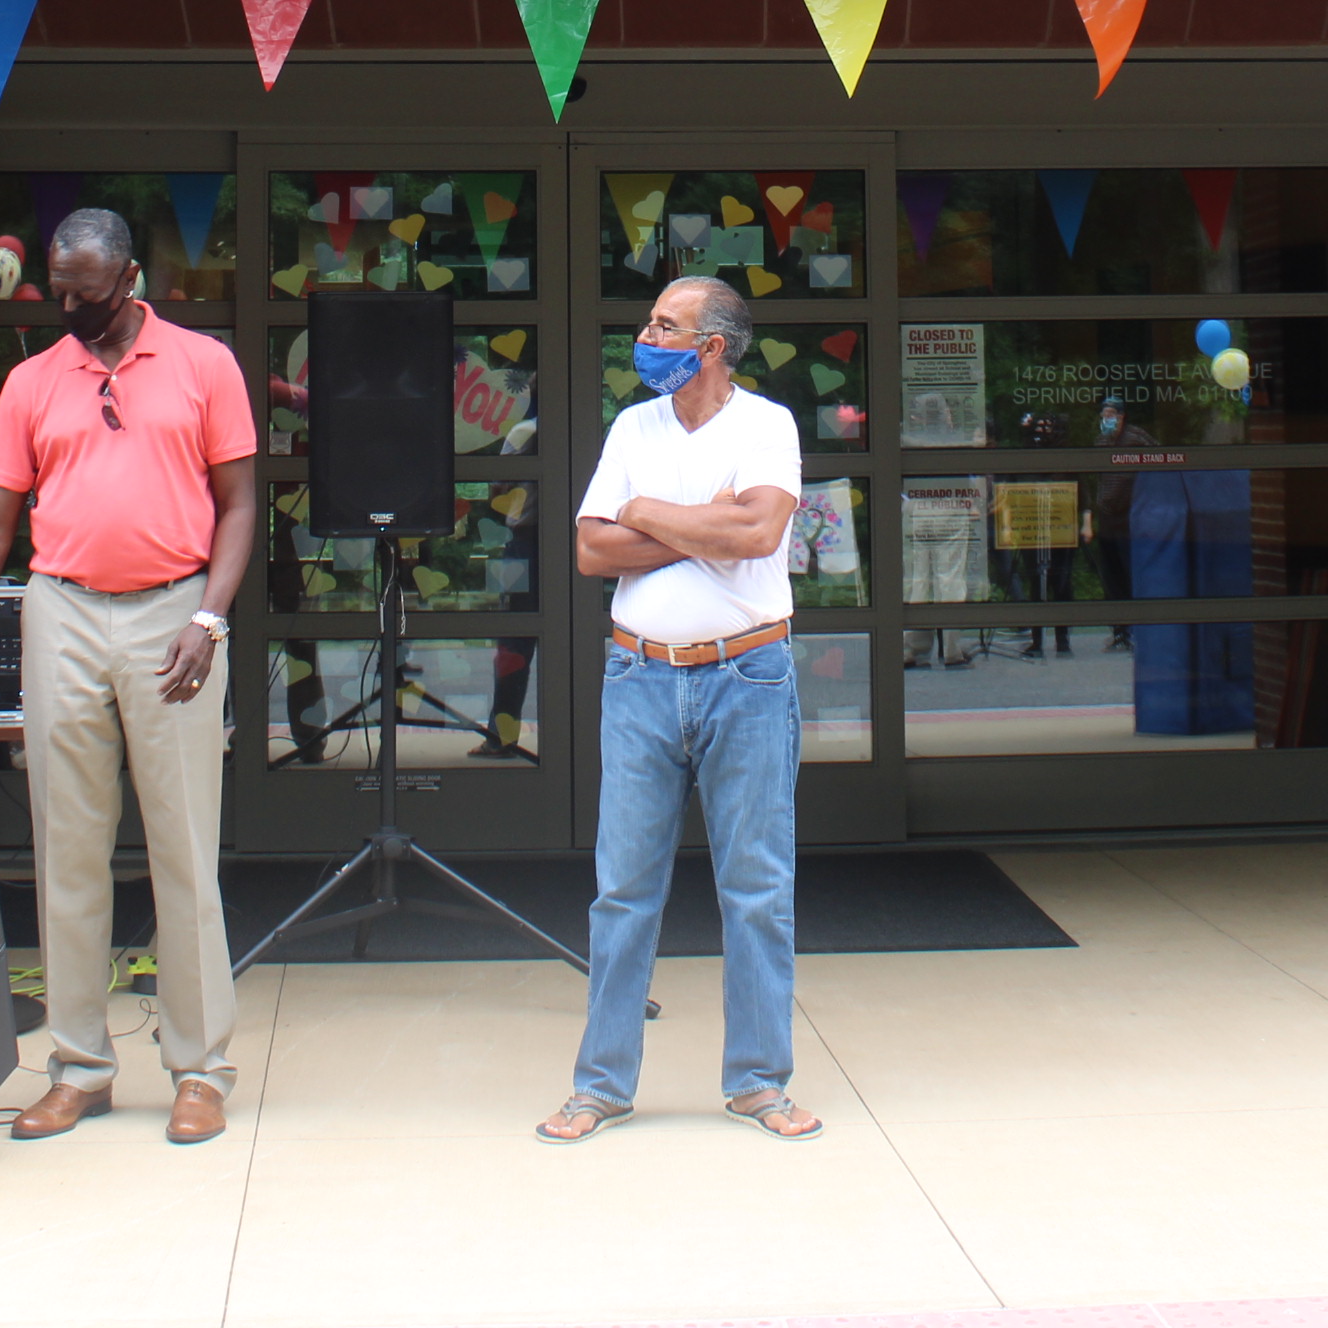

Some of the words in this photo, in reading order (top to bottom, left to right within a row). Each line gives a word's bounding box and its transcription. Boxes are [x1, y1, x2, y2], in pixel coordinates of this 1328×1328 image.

[908, 329, 956, 341] CLOSED
[958, 328, 975, 340] TO
[907, 343, 930, 355] THE
[933, 342, 977, 354] PUBLIC
[1012, 365, 1056, 382] 1476
[1063, 363, 1186, 381] ROOSEVELT
[1192, 362, 1273, 380] AVUE
[1012, 386, 1150, 405] SPRINGFIELD
[1156, 386, 1192, 404] MA,
[1112, 454, 1140, 463] CAUTION
[1142, 453, 1164, 463] STAND
[1167, 453, 1184, 463] BACK
[908, 489, 952, 499] CERRADO
[955, 488, 981, 498] PARA
[917, 500, 929, 510] EL
